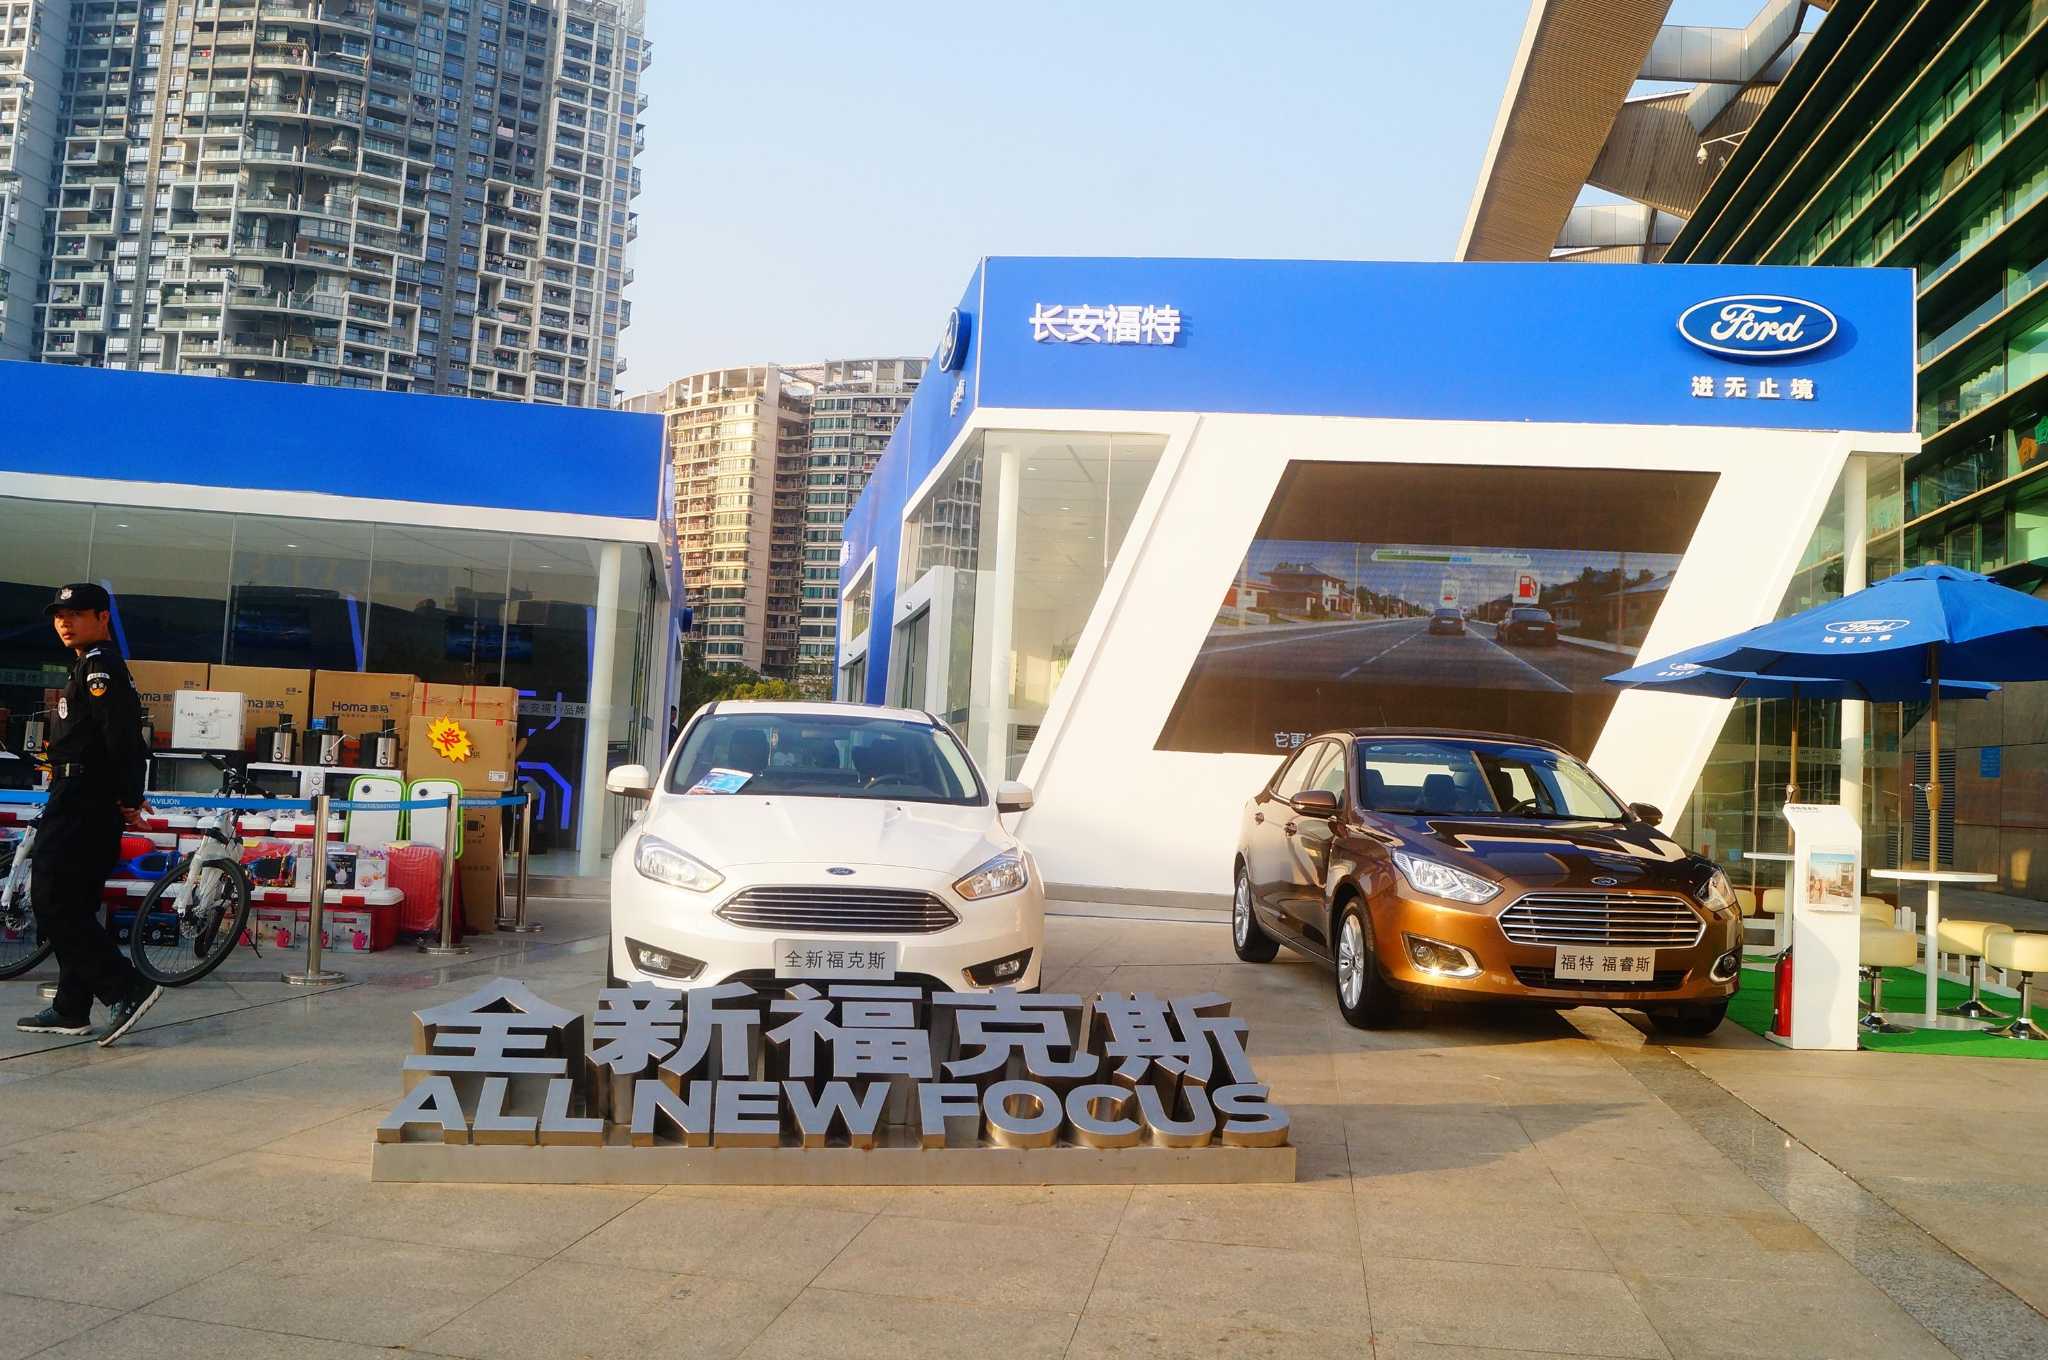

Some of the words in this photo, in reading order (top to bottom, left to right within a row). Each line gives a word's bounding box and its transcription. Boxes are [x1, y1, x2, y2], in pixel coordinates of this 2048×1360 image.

[1029, 303, 1181, 344] 长安福特
[1710, 302, 1806, 342] Ford
[1691, 375, 1816, 400] 进无止境
[332, 701, 368, 714] Homa
[1274, 731, 1312, 749] 它更
[784, 950, 886, 970] 全新福克斯
[1560, 953, 1594, 972] 福特
[1602, 955, 1651, 974] 福睿斯
[402, 977, 1250, 1085] 全新福克斯
[376, 1074, 605, 1142] ALL
[630, 1079, 890, 1147] NEW
[920, 1082, 1290, 1148] FOCUS
